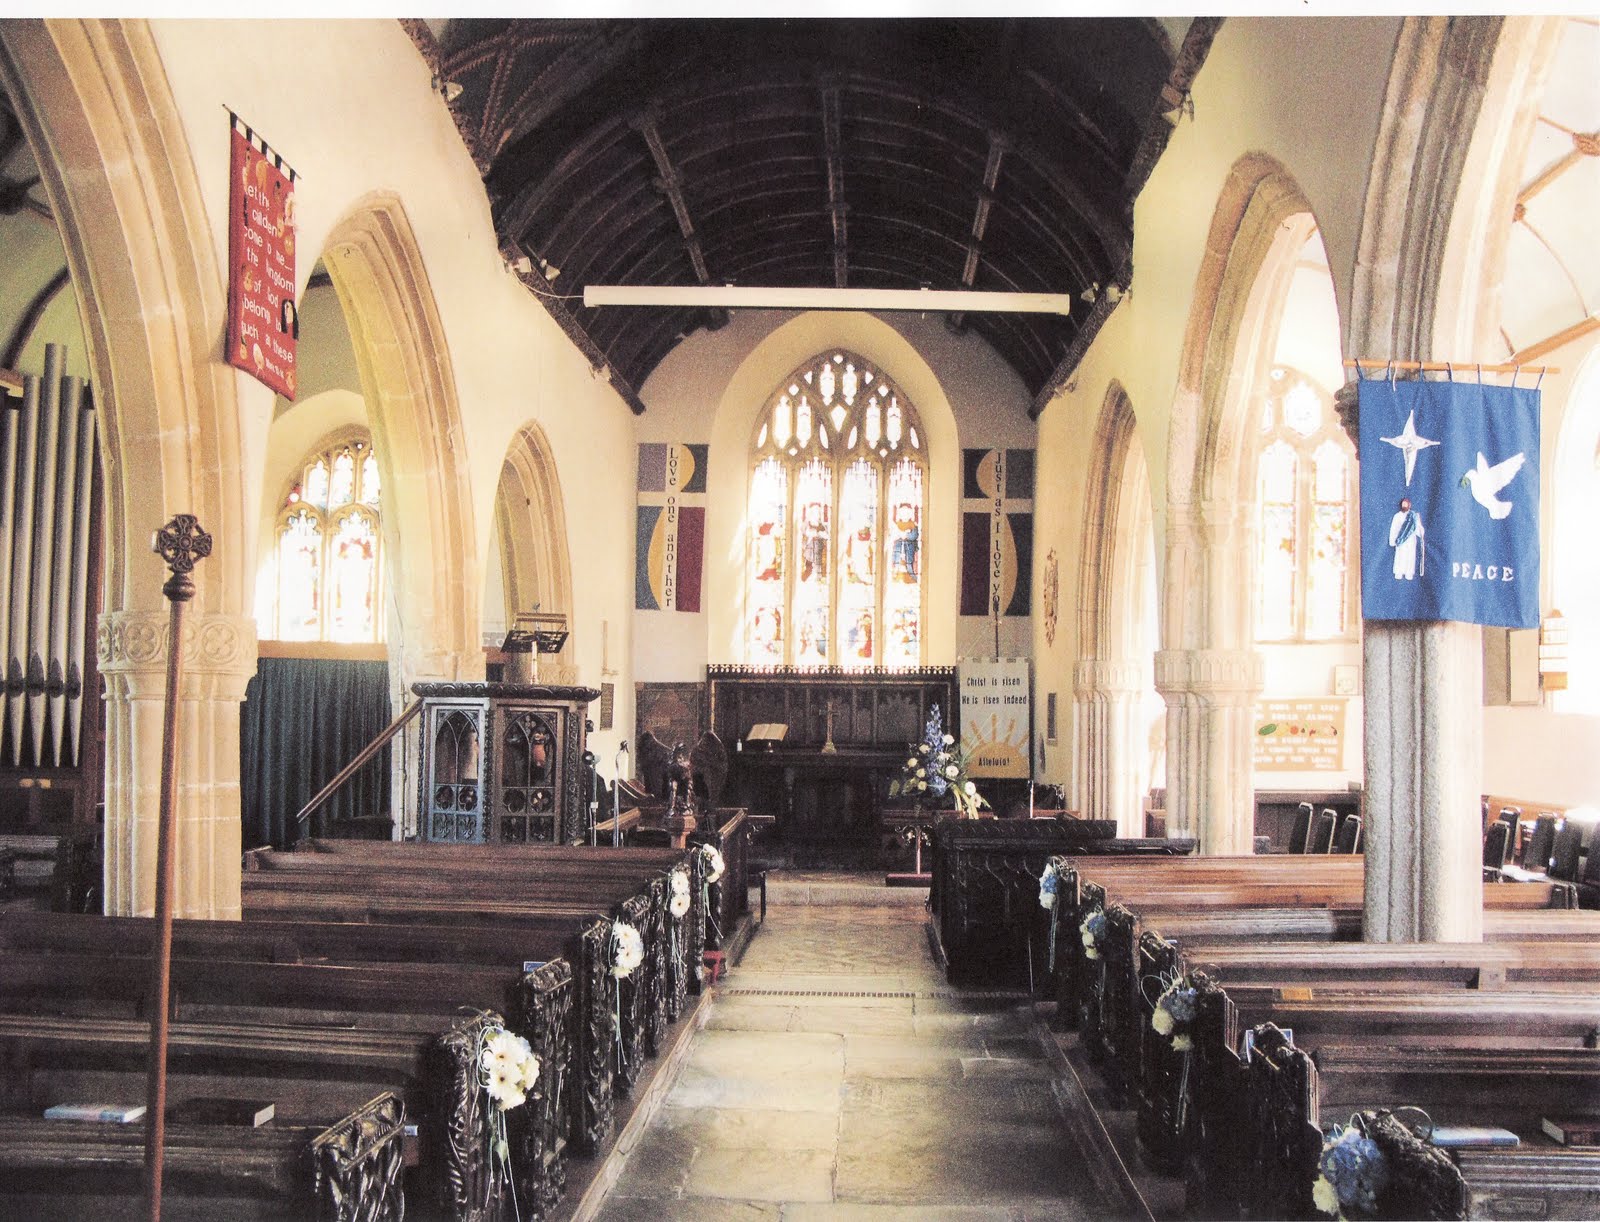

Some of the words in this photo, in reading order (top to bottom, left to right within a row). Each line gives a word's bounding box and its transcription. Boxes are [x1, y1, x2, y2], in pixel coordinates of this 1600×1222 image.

[245, 185, 258, 200] et
[258, 191, 270, 211] th
[253, 280, 262, 294] of
[265, 333, 272, 348] a
[1452, 561, 1514, 582] PEACE
[966, 677, 986, 687] Christ
[991, 677, 998, 686] is
[1002, 676, 1020, 686] risen
[961, 696, 970, 705] He
[972, 695, 978, 705] is
[1004, 695, 1027, 705] indeed
